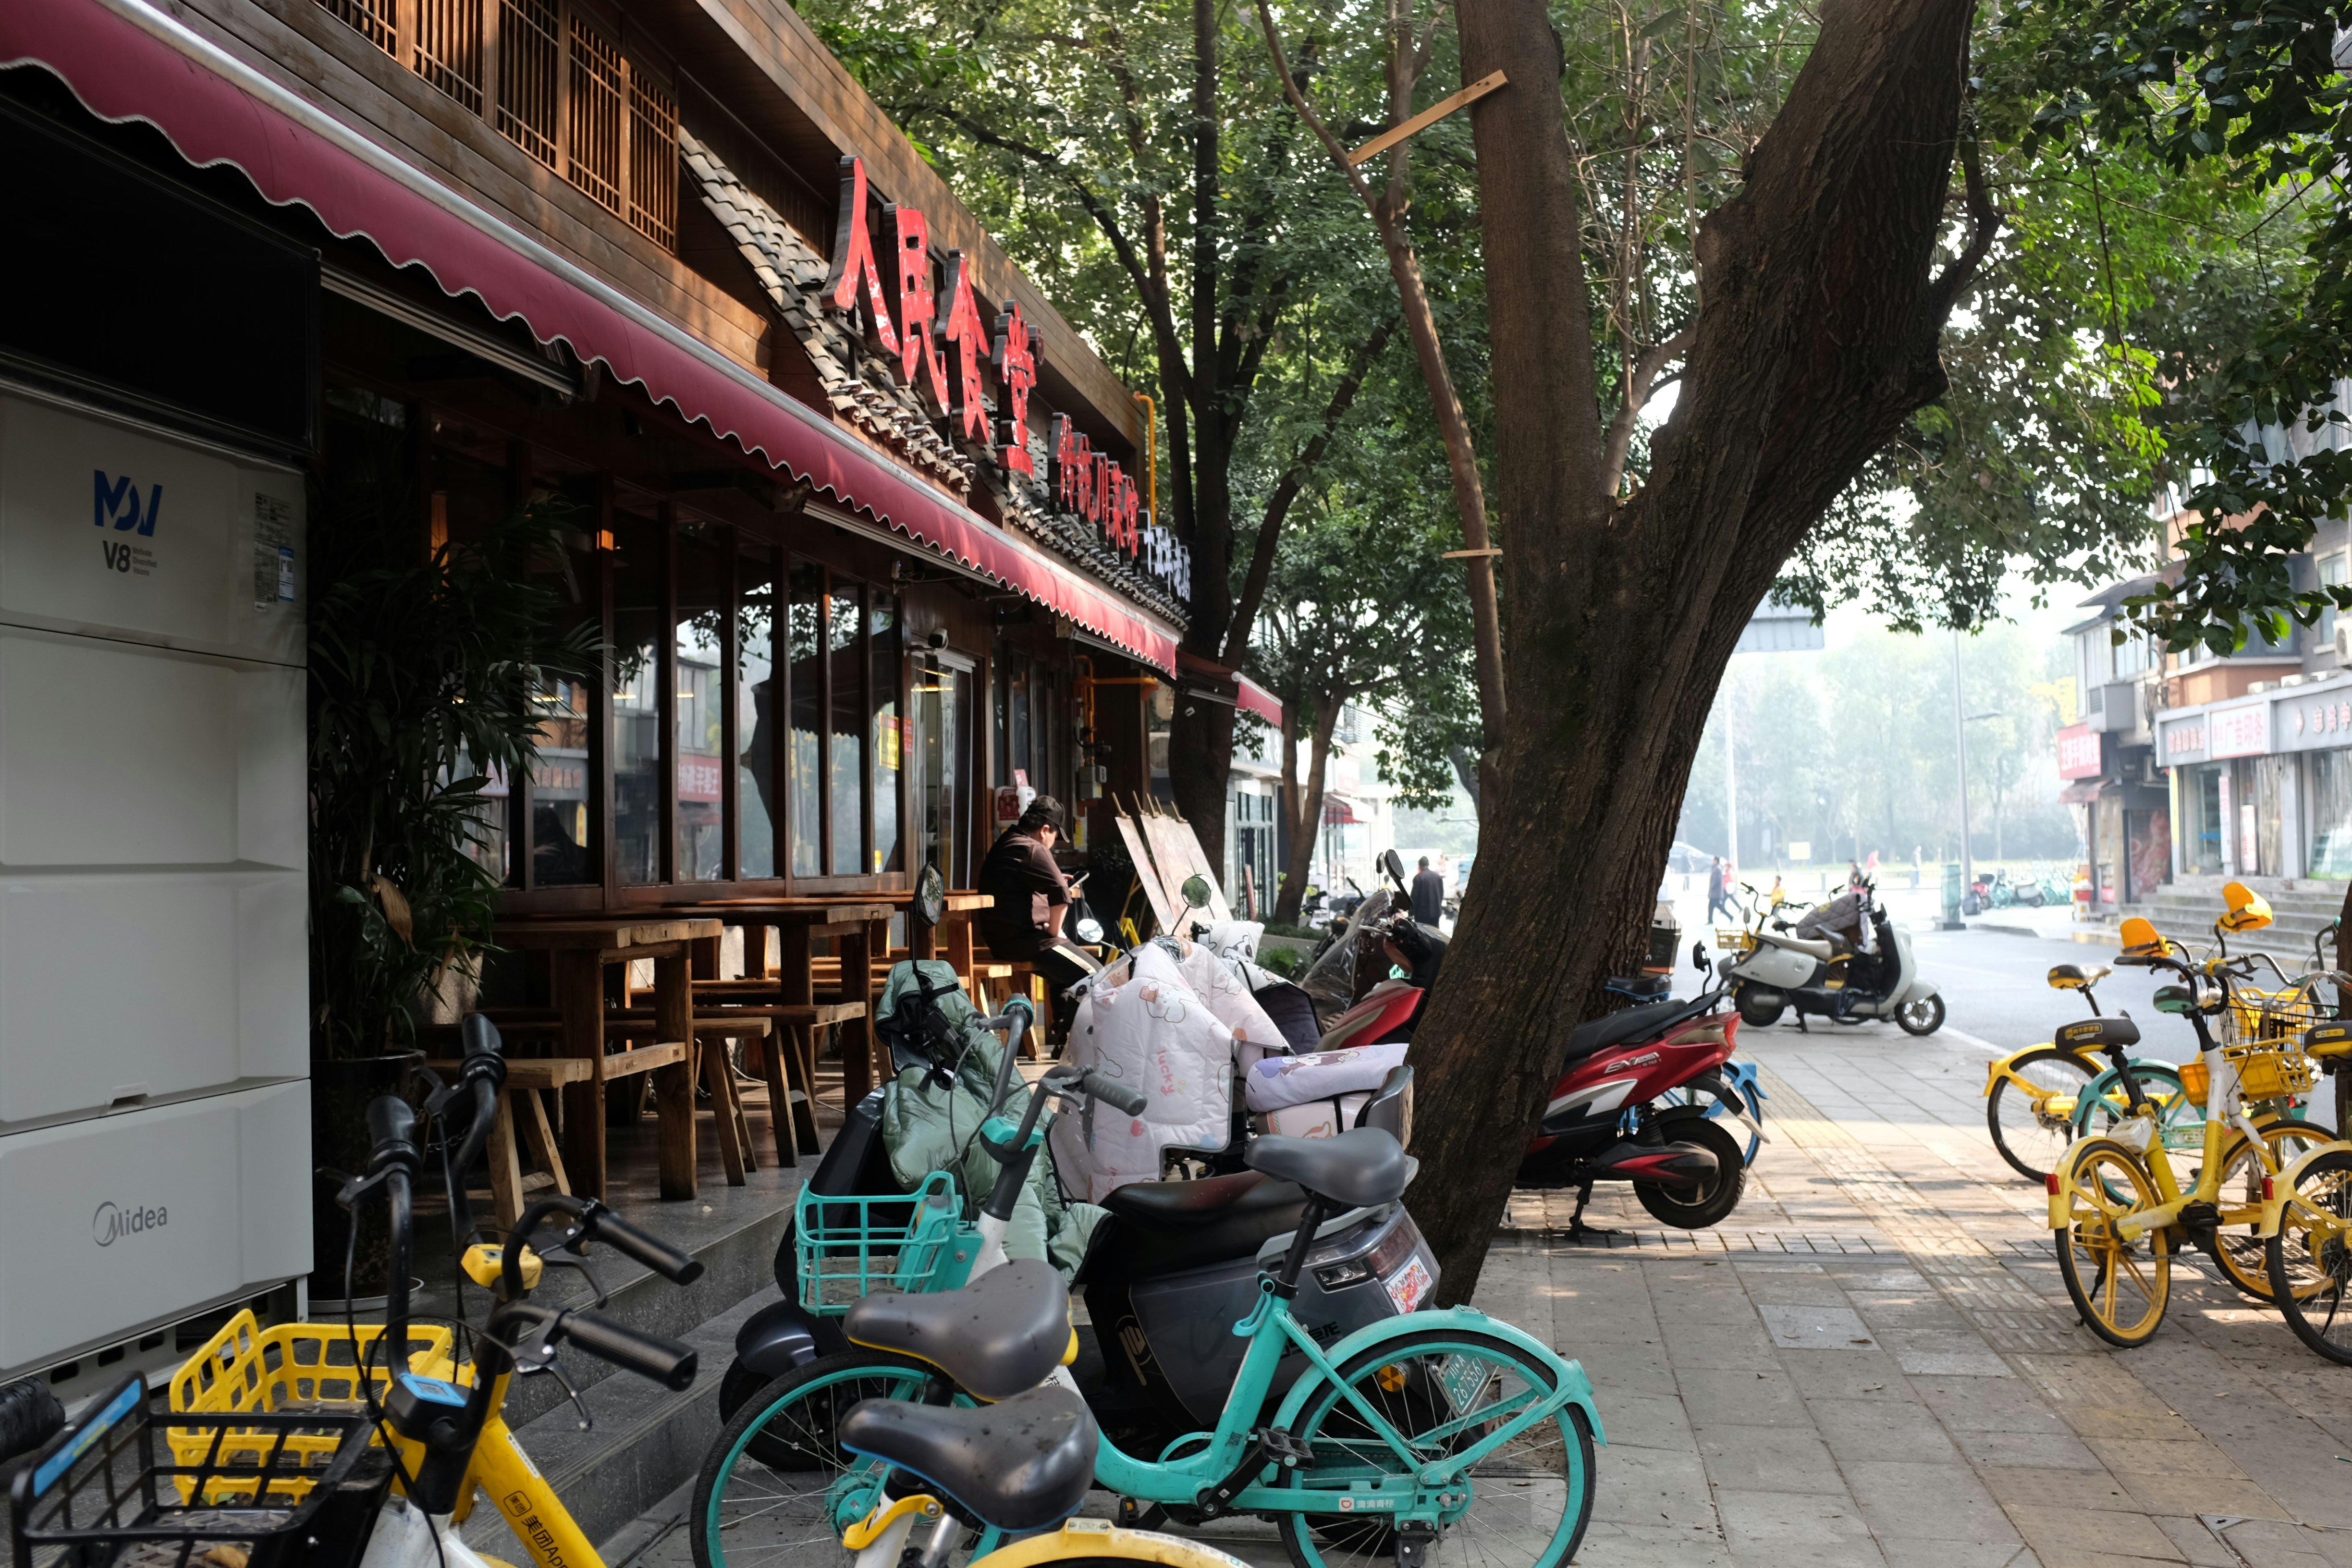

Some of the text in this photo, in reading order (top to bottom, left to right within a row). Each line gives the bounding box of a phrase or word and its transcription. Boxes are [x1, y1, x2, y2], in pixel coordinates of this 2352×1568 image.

[833, 156, 1044, 480] 人民食堂
[1143, 510, 1190, 600] 十五年老店
[102, 540, 131, 573] V8
[1157, 1050, 1175, 1096] lucky
[93, 1201, 167, 1247] Midea
[1453, 1360, 1482, 1406] 267556
[509, 1495, 526, 1513] 美团
[1356, 1499, 1395, 1509] 滴滴青桔
